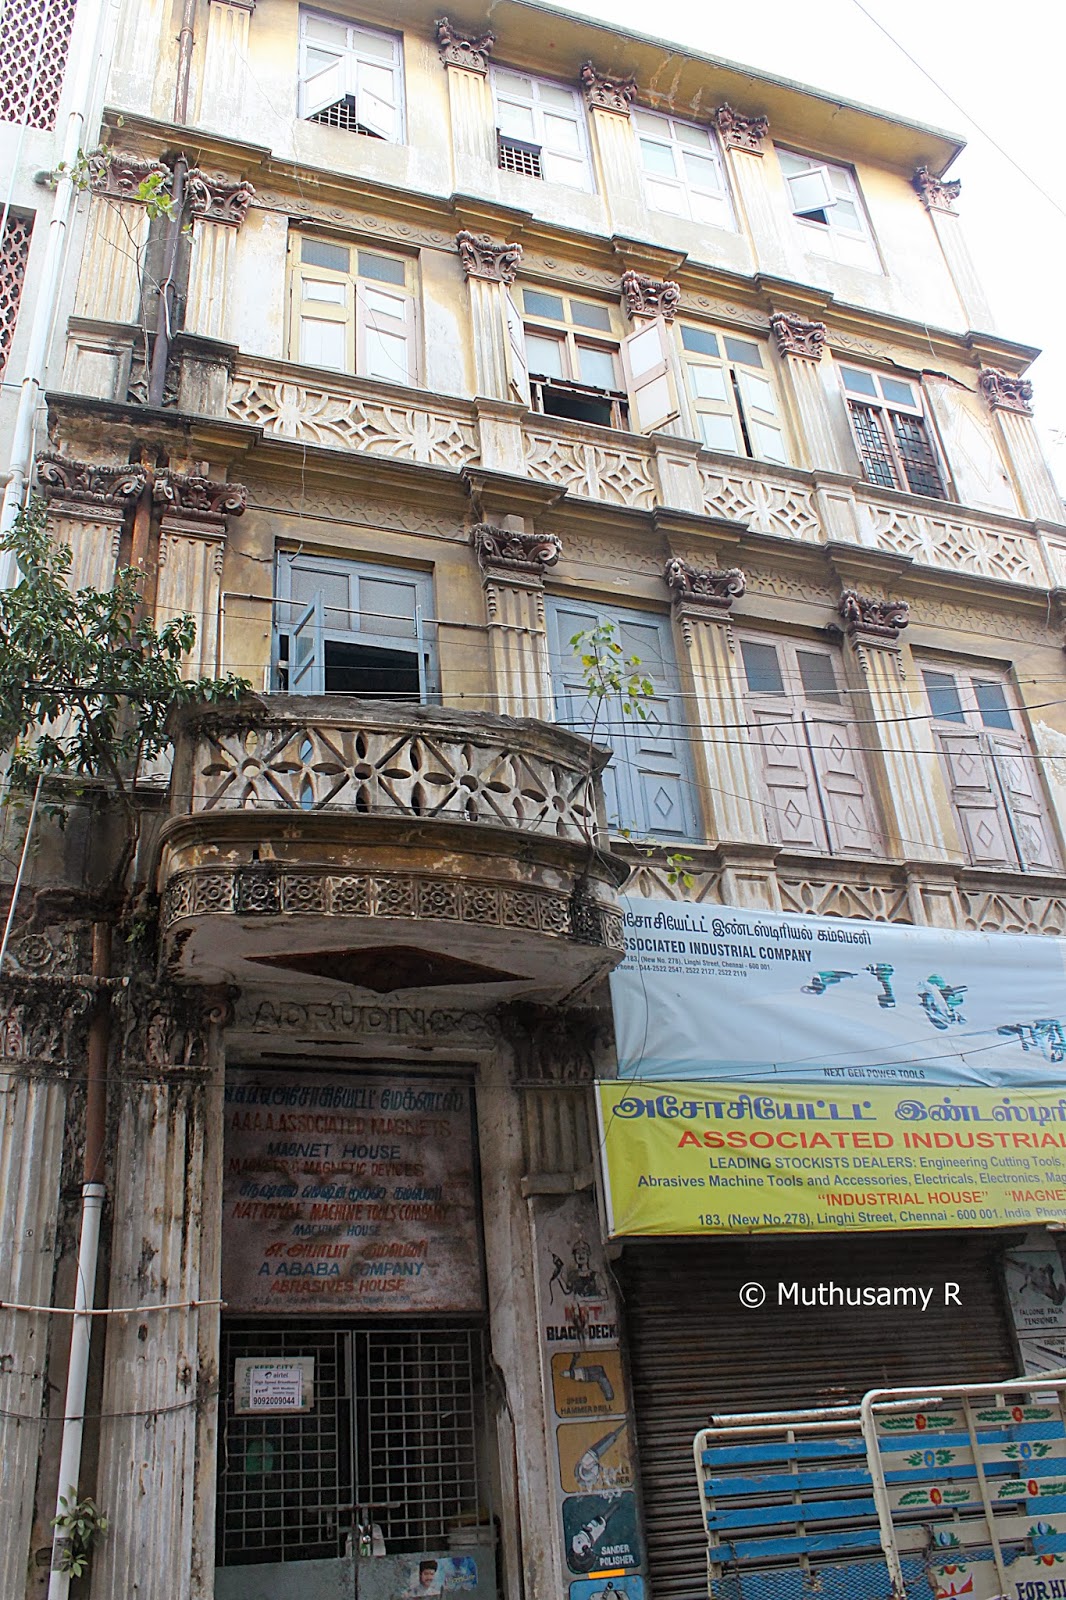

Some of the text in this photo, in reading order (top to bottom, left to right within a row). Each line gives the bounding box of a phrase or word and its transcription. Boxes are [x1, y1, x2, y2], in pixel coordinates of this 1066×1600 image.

[623, 912, 709, 933] சோசியேட்டட்
[817, 927, 872, 945] கம்பெனி
[624, 937, 813, 963] SSOCIATED INDUSTRIAL COMPANY
[823, 1067, 925, 1079] NEXT GEN POWER TOOLS
[613, 1094, 877, 1121] அசோசியேட்டட்
[678, 1131, 894, 1150] ASSOCIATED
[266, 1142, 402, 1160] MAGNET HOUSE
[371, 1161, 425, 1177] DEVICES
[710, 1155, 1065, 1171] LEADING STOCKISTS DEALERS: Engineering Cutting Tools,
[637, 1175, 705, 1188] Abrasives
[708, 1174, 764, 1187] Machine
[767, 1174, 803, 1187] Tools
[806, 1174, 830, 1187] and
[833, 1174, 912, 1188] Accessories,
[915, 1173, 977, 1187] Electricals,
[980, 1173, 1044, 1186] Electronics,
[1004, 1189, 1066, 1203] “MAGNE
[309, 1203, 361, 1222] MACHINE
[366, 1204, 396, 1222] TOOLS
[698, 1213, 725, 1227] 183,
[728, 1211, 760, 1227] (New
[763, 1210, 814, 1227] No.278),
[817, 1210, 855, 1227] Linghi
[858, 1210, 896, 1225] Street,
[900, 1208, 947, 1223] Chennai
[956, 1208, 977, 1222] 600
[979, 1207, 1002, 1221] 001.
[1004, 1206, 1031, 1219] India
[346, 1225, 382, 1237] HOUSE
[257, 1262, 426, 1277] A ABABA COMPANY
[271, 1279, 405, 1294] ABRASIVES HOUSE
[254, 1397, 295, 1405] 9092009044
[560, 1406, 592, 1415] HAMMER
[601, 1543, 631, 1556] SANDER
[599, 1554, 635, 1567] POLISHER
[1015, 1582, 1047, 1600] FOR
